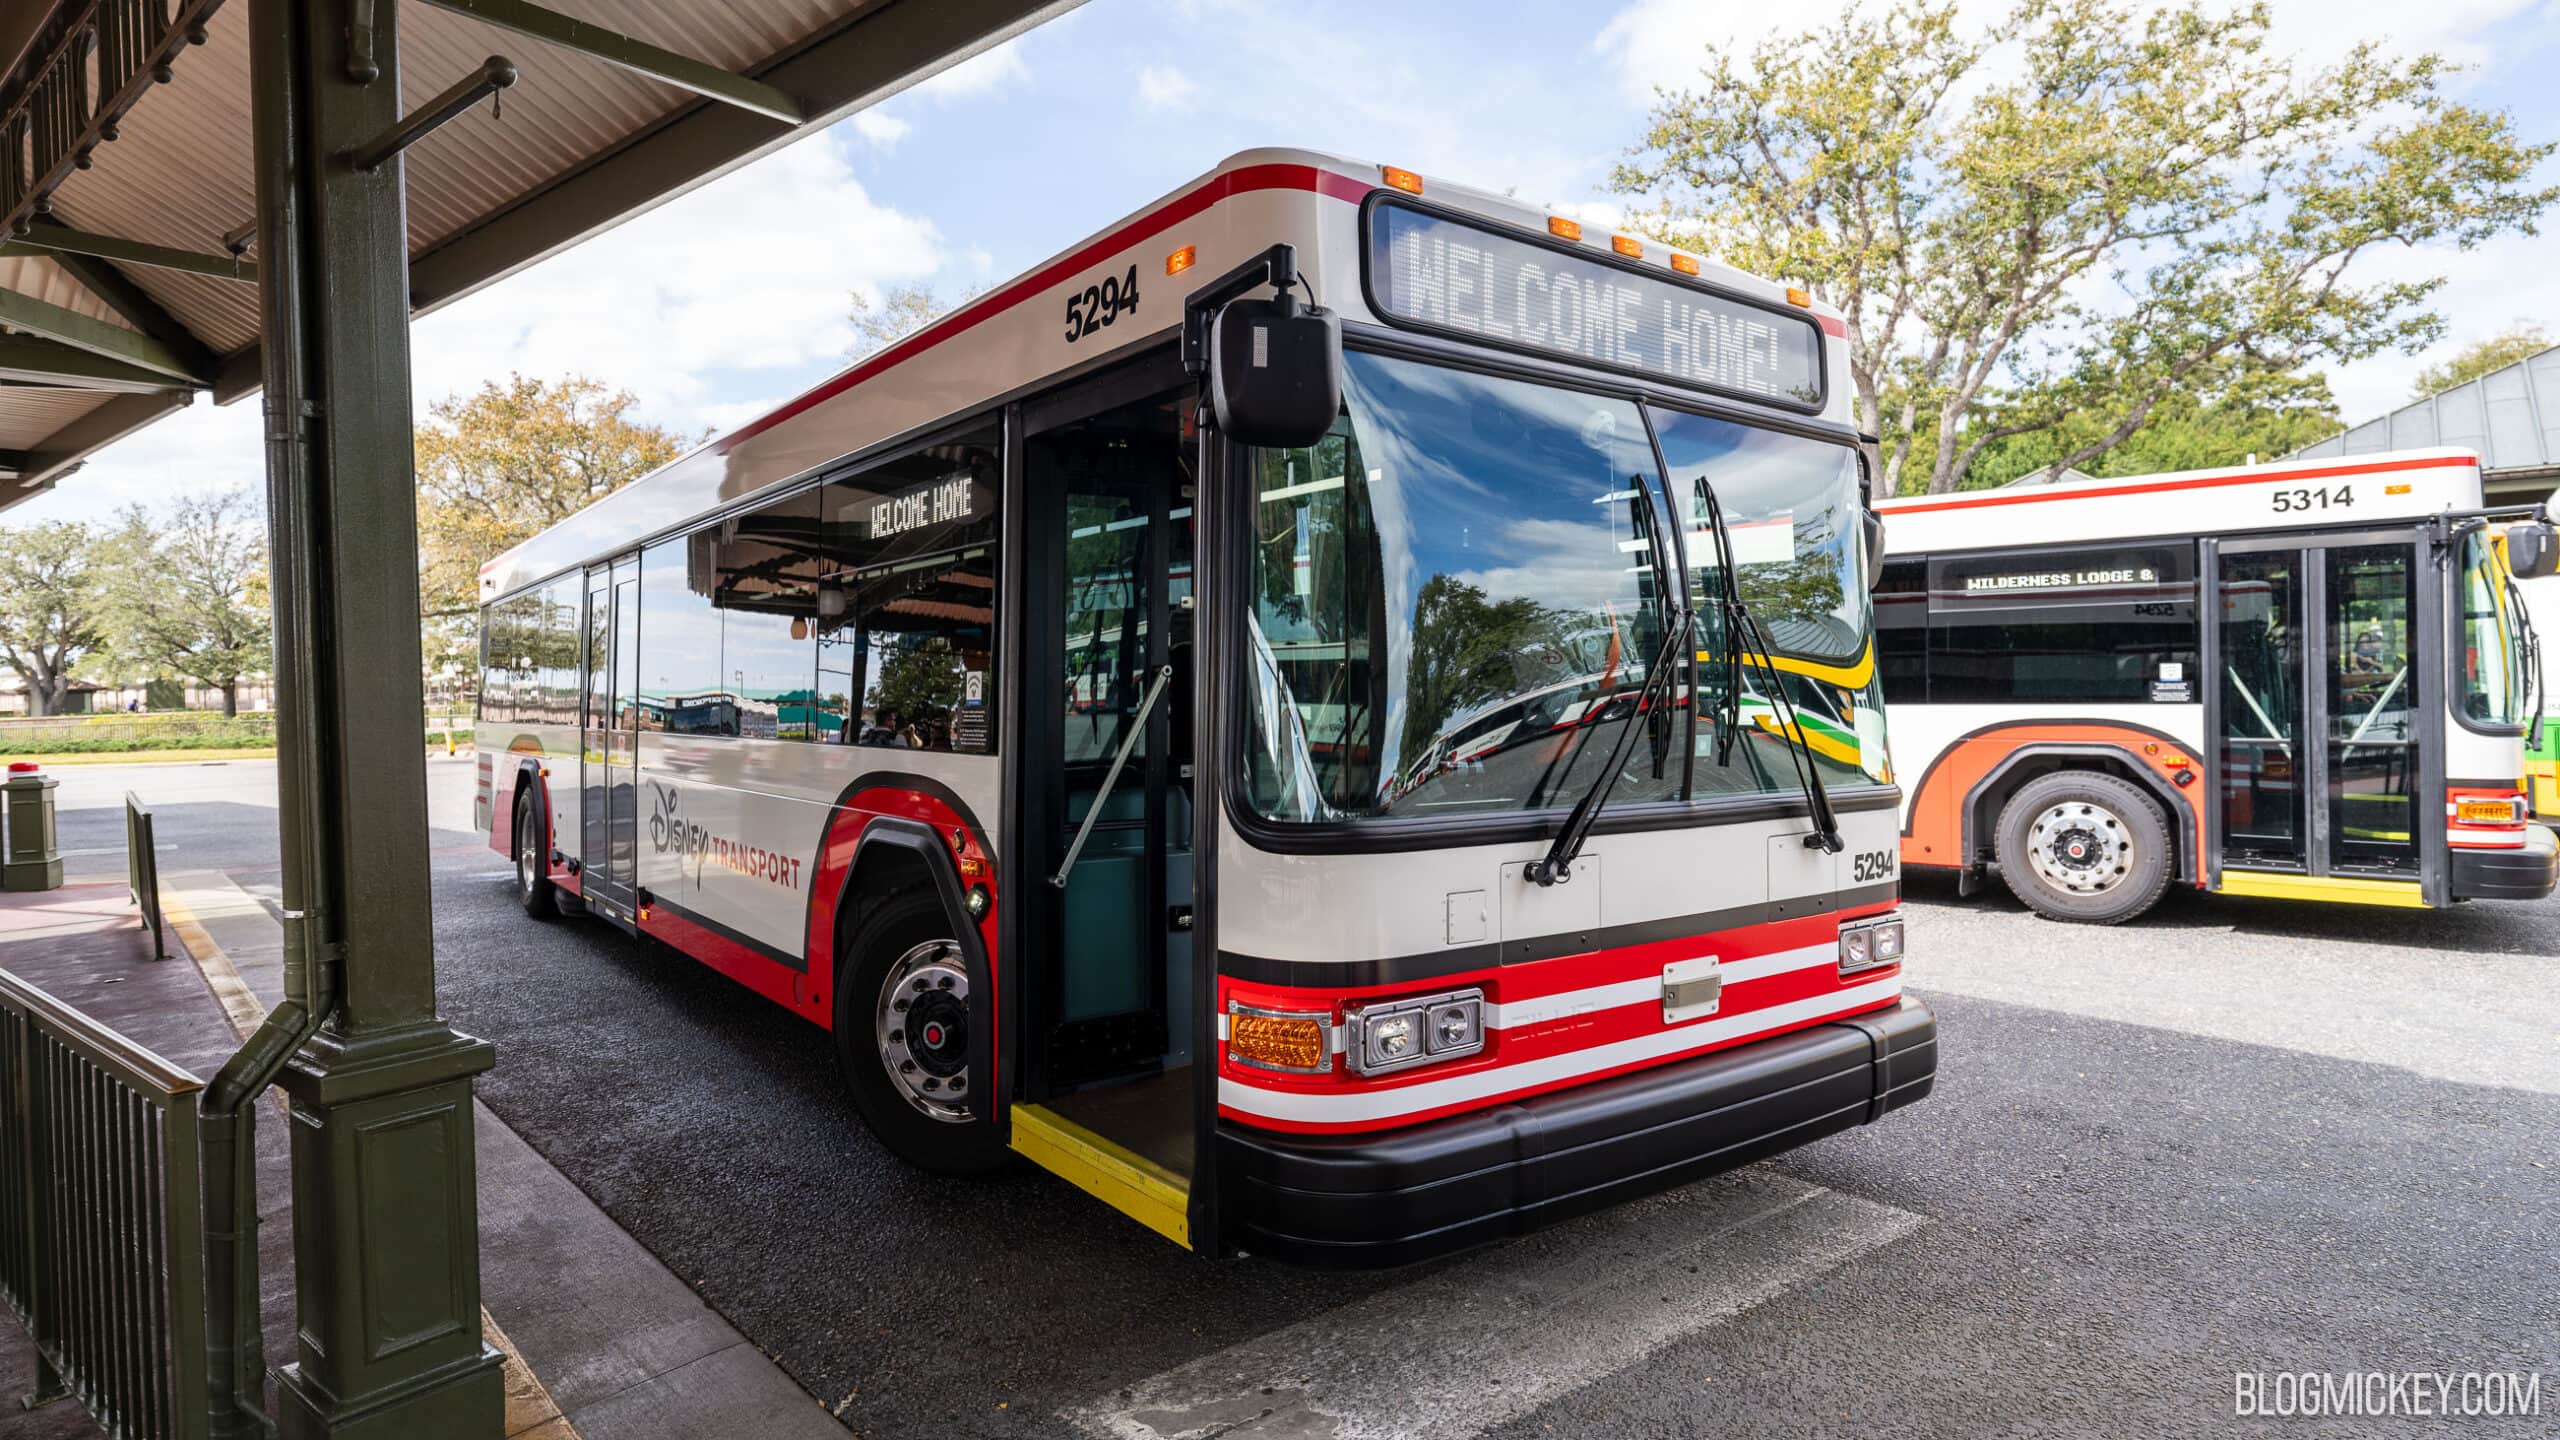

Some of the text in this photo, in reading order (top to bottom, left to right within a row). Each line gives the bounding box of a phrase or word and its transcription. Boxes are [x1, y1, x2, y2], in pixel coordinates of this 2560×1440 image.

[1065, 264, 1139, 343] 5294
[1409, 231, 1779, 396] WELCOME HOME!
[871, 477, 972, 539] WELCOME HOME
[2272, 485, 2355, 513] 5314
[1967, 569, 2153, 590] WILDERNESS LODGE &
[712, 836, 800, 890] TRANSPORT
[1854, 848, 1894, 882] 5294
